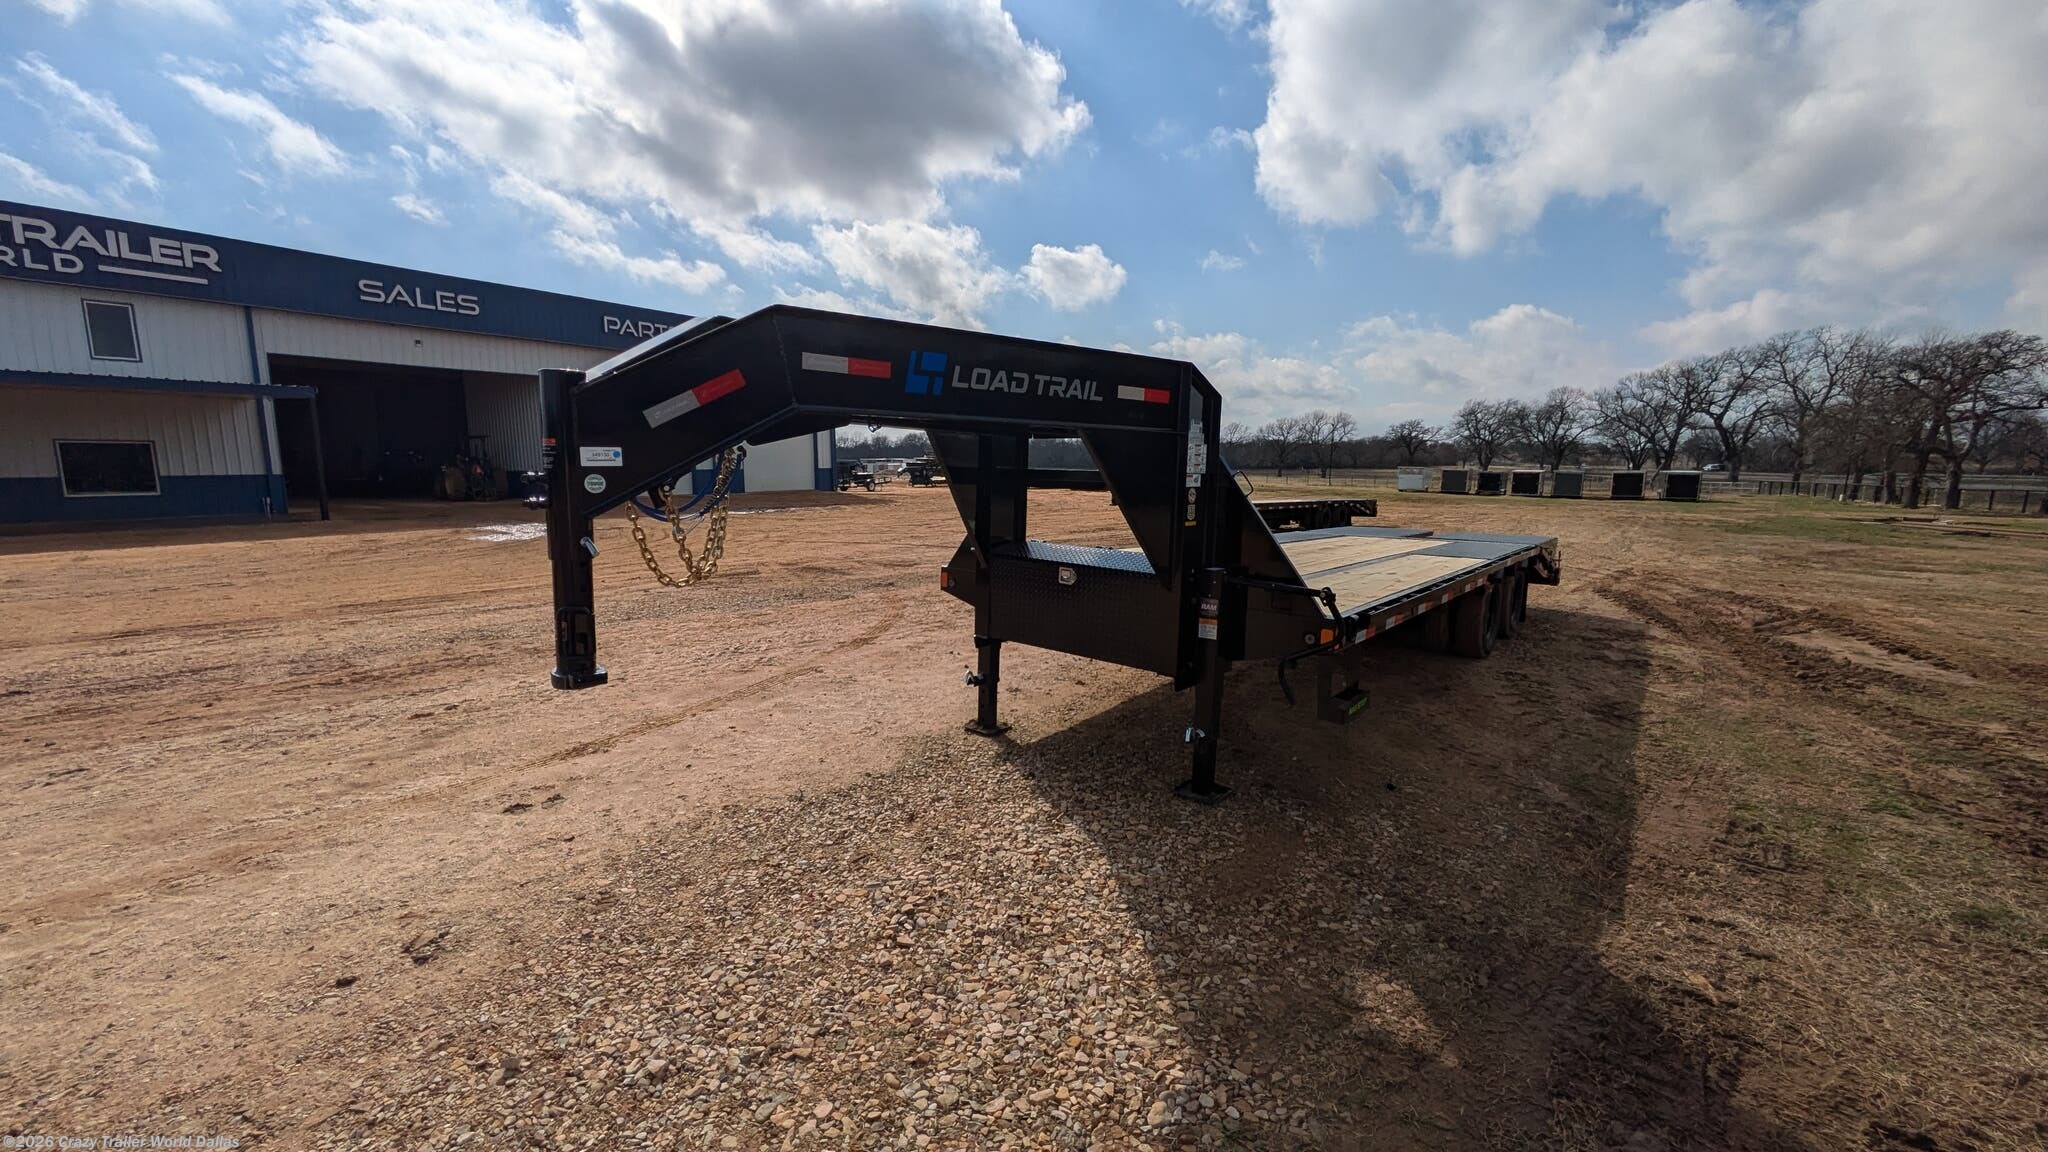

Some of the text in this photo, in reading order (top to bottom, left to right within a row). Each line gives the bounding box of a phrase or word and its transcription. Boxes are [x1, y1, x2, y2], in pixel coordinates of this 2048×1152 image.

[0, 213, 222, 273] RAILER
[358, 279, 480, 316] SALES
[603, 315, 674, 339] PART
[951, 365, 1104, 402] LOAD TRAIL
